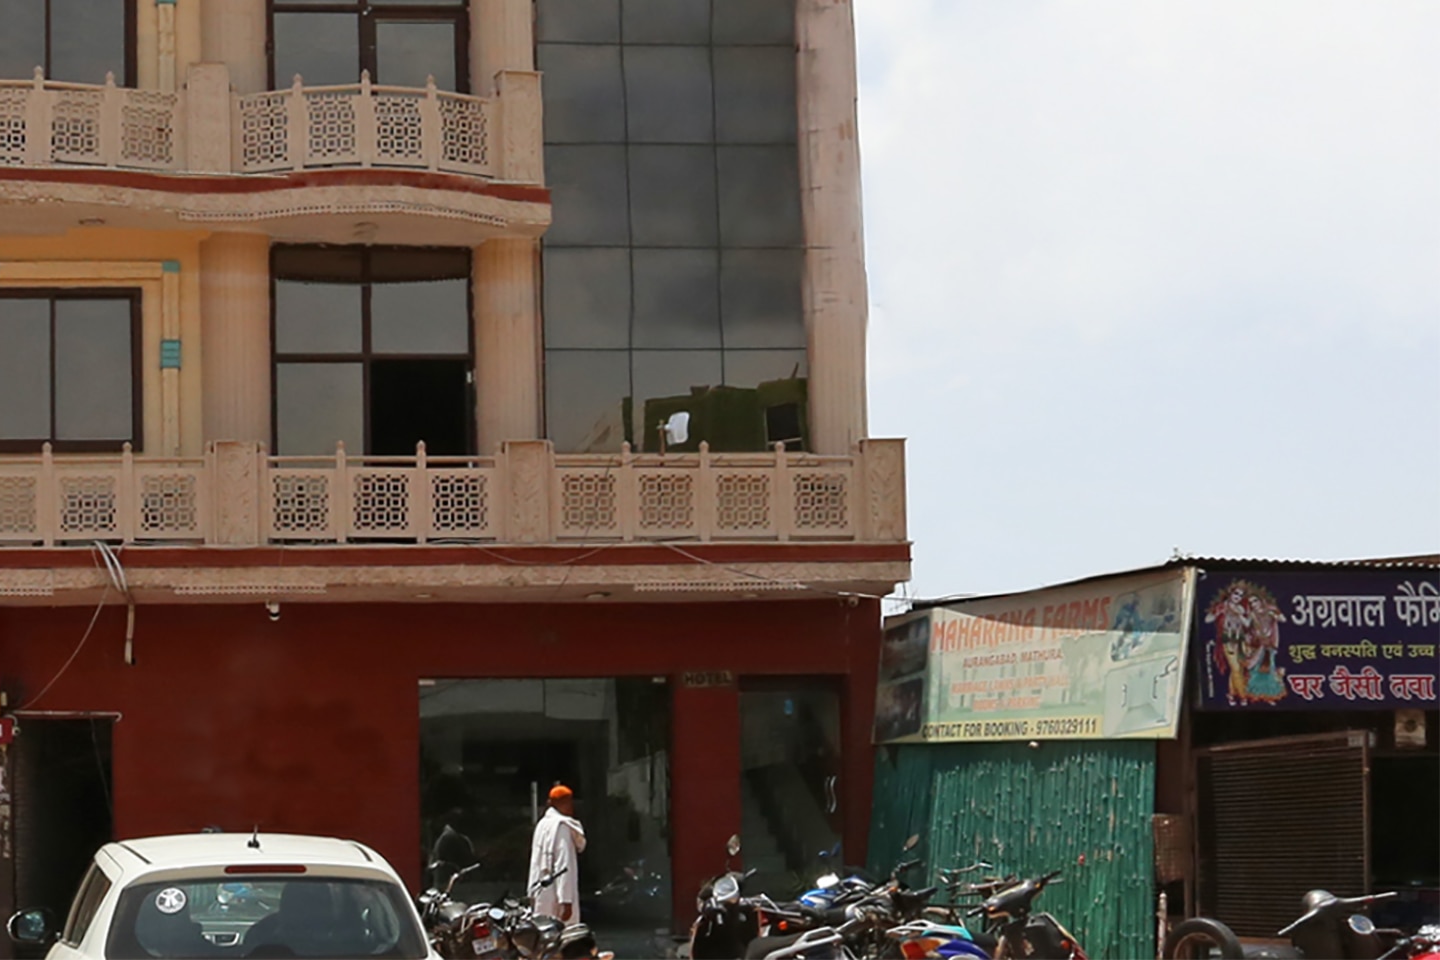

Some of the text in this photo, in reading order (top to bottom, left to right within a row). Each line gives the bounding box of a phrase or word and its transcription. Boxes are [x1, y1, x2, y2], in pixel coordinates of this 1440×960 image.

[930, 596, 1111, 652] MAHARANA FARMS
[1290, 594, 1387, 628] अग्रवाल
[1320, 639, 1378, 659] वनस्पति
[1382, 640, 1404, 659] एवं
[1408, 643, 1436, 658] उच्च
[1286, 665, 1437, 700] घर जैसी तवा
[922, 723, 963, 738] CONTACT
[964, 722, 983, 738] FOR
[983, 721, 1029, 737] BOOKING
